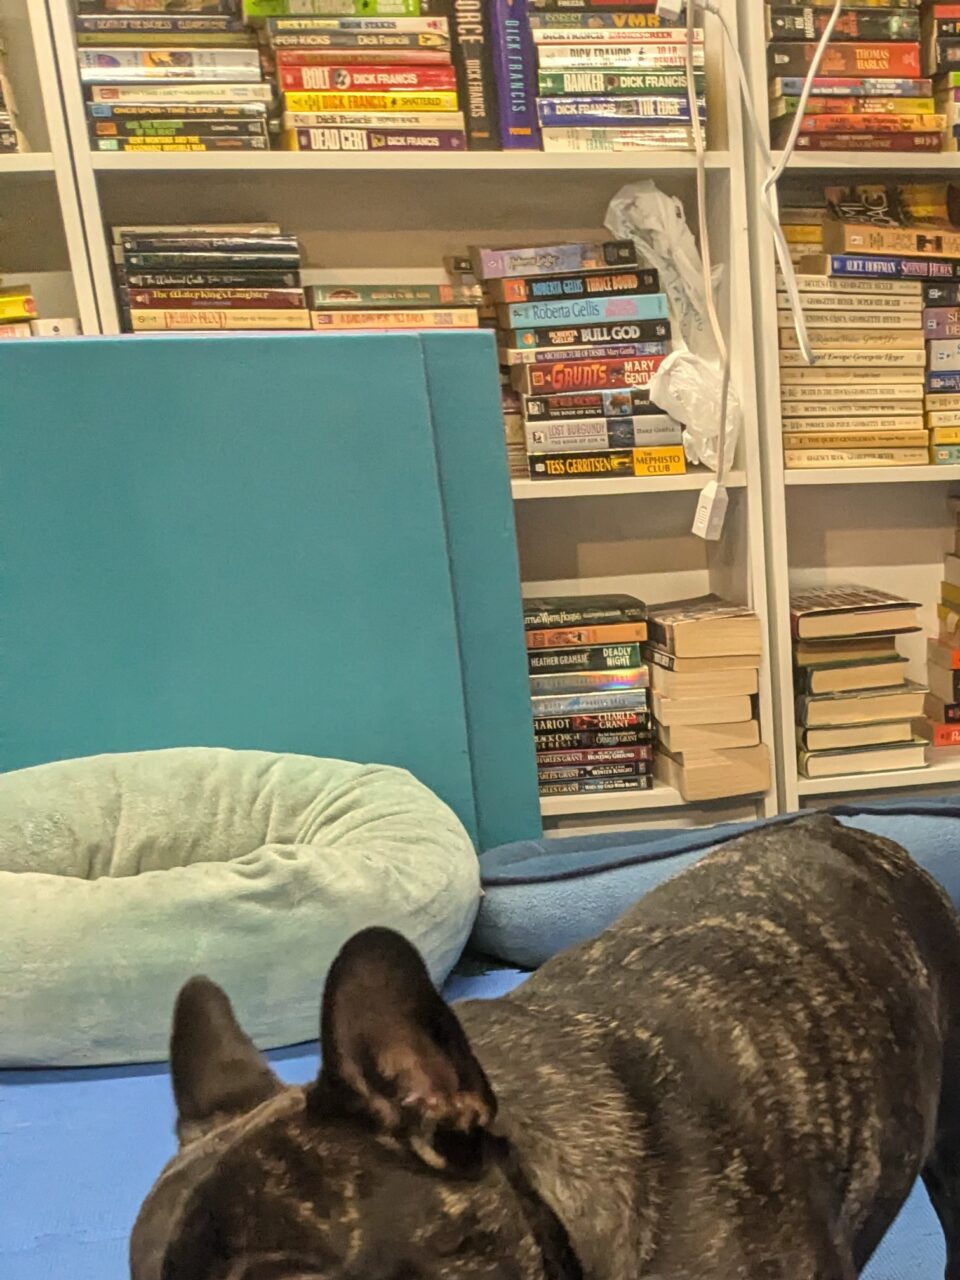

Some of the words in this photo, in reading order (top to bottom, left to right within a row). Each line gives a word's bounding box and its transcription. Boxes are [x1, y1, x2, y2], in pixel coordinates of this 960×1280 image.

[505, 20, 521, 50] DICK
[855, 49, 890, 59] THOMAS
[466, 59, 480, 80] DICK
[857, 59, 889, 70] HARLAN
[301, 67, 330, 90] BOLT
[353, 75, 377, 85] DICK
[377, 75, 418, 85] FRANCIS
[507, 55, 527, 113] FRANCIS
[563, 74, 605, 91] BANKER
[620, 77, 644, 88] DICK
[645, 76, 688, 88] FRANCIS
[322, 95, 345, 110] DICK
[348, 95, 387, 109] FRANCIS
[400, 98, 442, 108] SHATTERED
[468, 81, 486, 118] FRANCIS
[555, 103, 577, 116] DICK
[578, 103, 616, 115] FRANCIS
[310, 129, 340, 150] DEAD
[341, 129, 369, 150] CERT
[387, 136, 407, 146] DICK
[407, 136, 440, 147] FRANCIS
[532, 304, 571, 321] Roberta
[572, 302, 600, 318] Gellis
[580, 328, 611, 343] BULL
[611, 326, 641, 341] GOD
[551, 363, 608, 390] GRUNTS
[624, 360, 655, 371] MARY
[544, 459, 565, 475] TESS
[565, 457, 612, 474] GERRITSEN
[635, 456, 681, 465] MEPHISTO
[647, 464, 671, 473] CLUB
[530, 654, 560, 668] HEATHER
[606, 656, 631, 667] NIGHT
[602, 647, 632, 661] DEADLY
[597, 711, 637, 722] CHARLES
[532, 719, 571, 730] HARIOT
[598, 720, 629, 730] GRANT
[537, 755, 562, 764] HARLES
